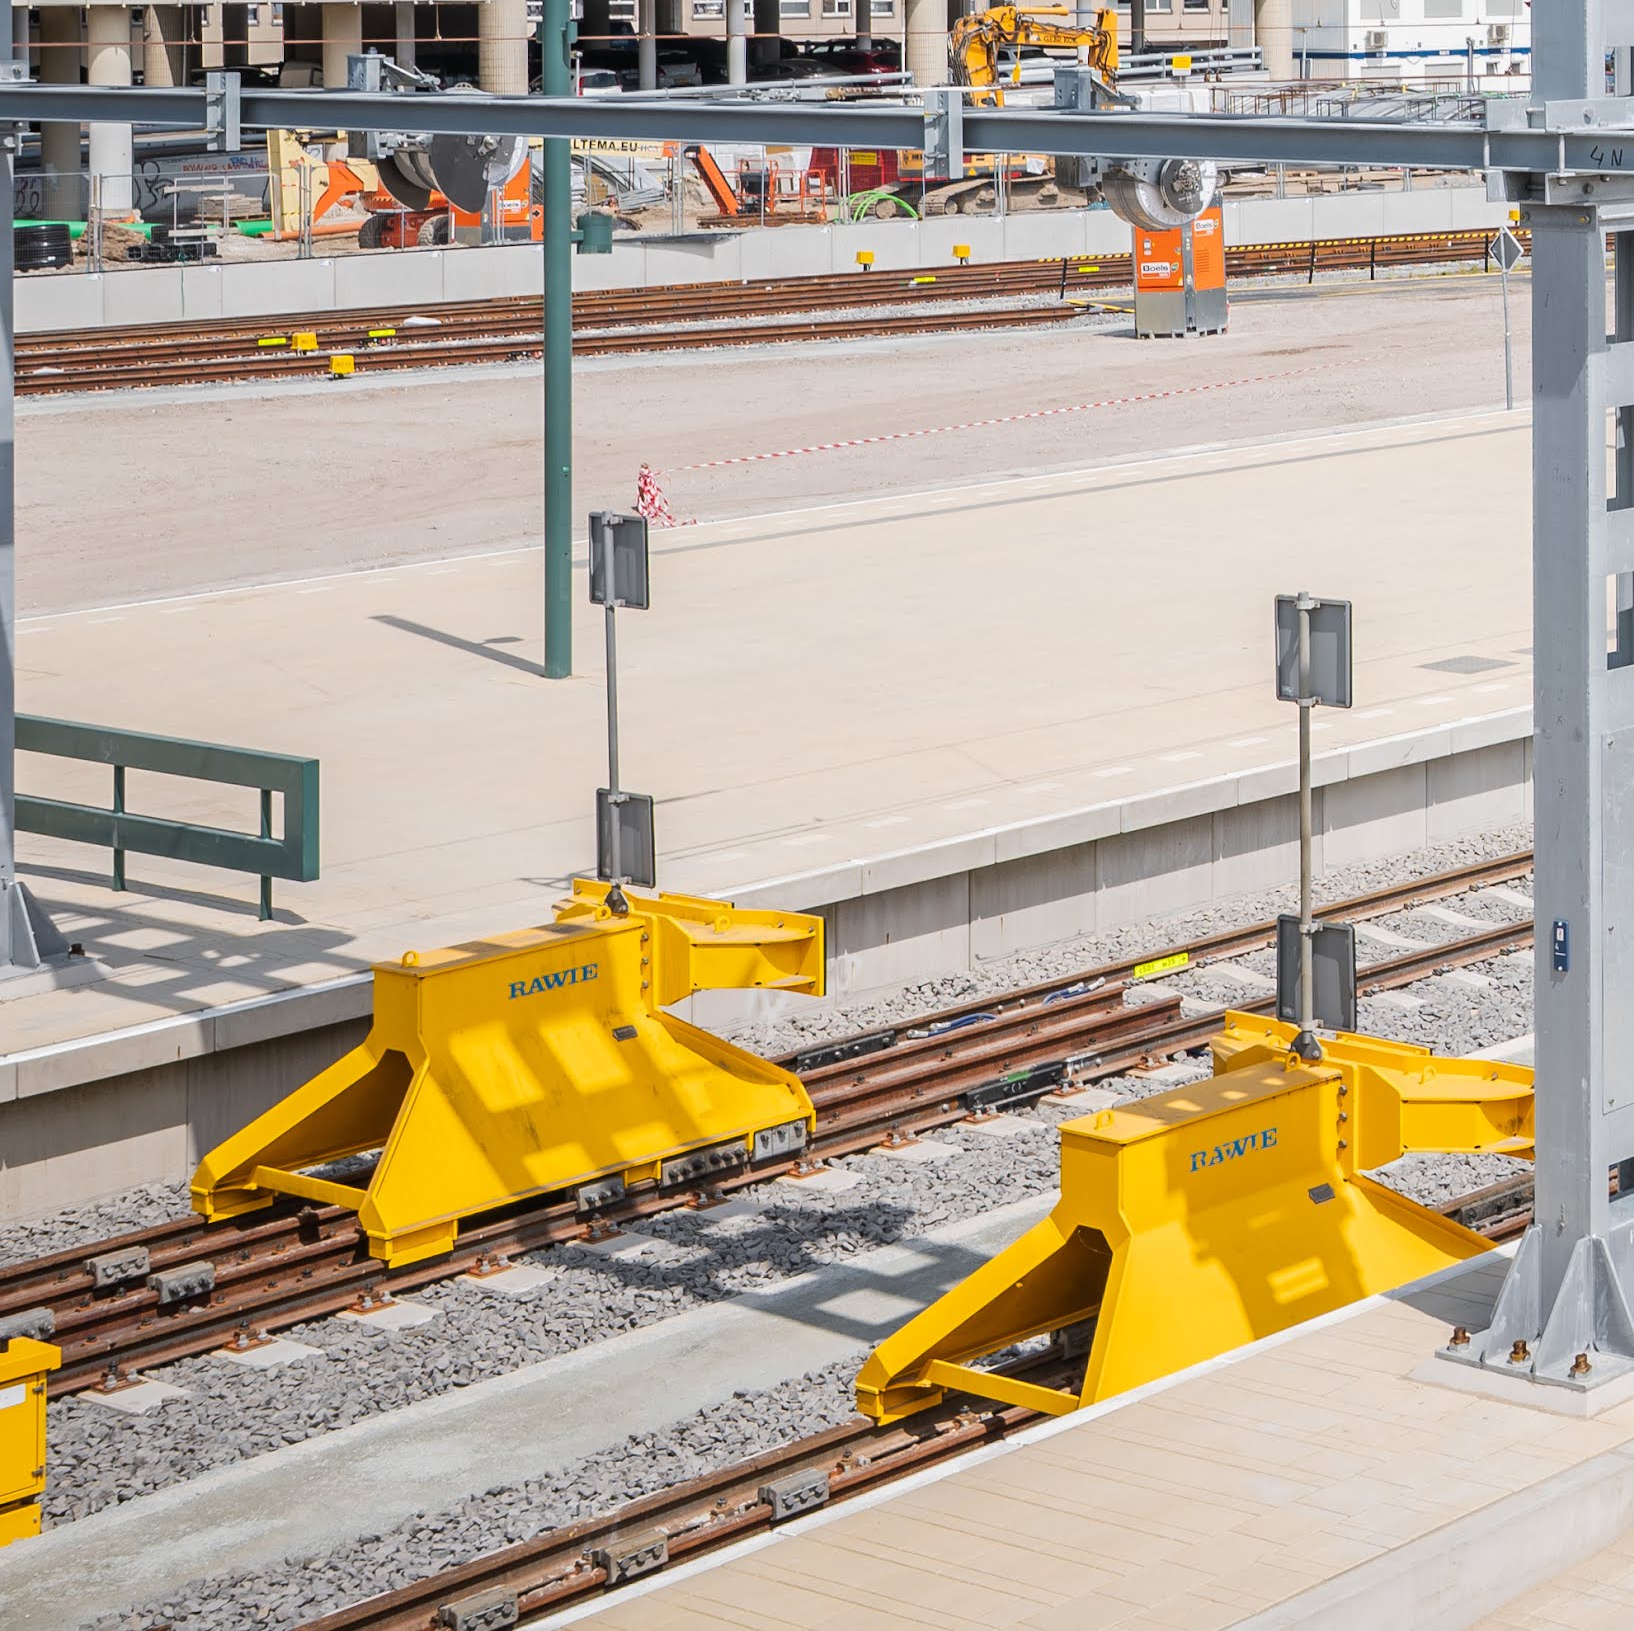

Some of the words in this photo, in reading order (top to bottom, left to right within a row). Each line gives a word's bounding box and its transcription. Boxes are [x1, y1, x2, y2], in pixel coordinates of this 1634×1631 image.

[1142, 264, 1169, 273] Boels
[508, 963, 599, 1000] RAWIE
[1189, 1127, 1278, 1172] RAWIE
